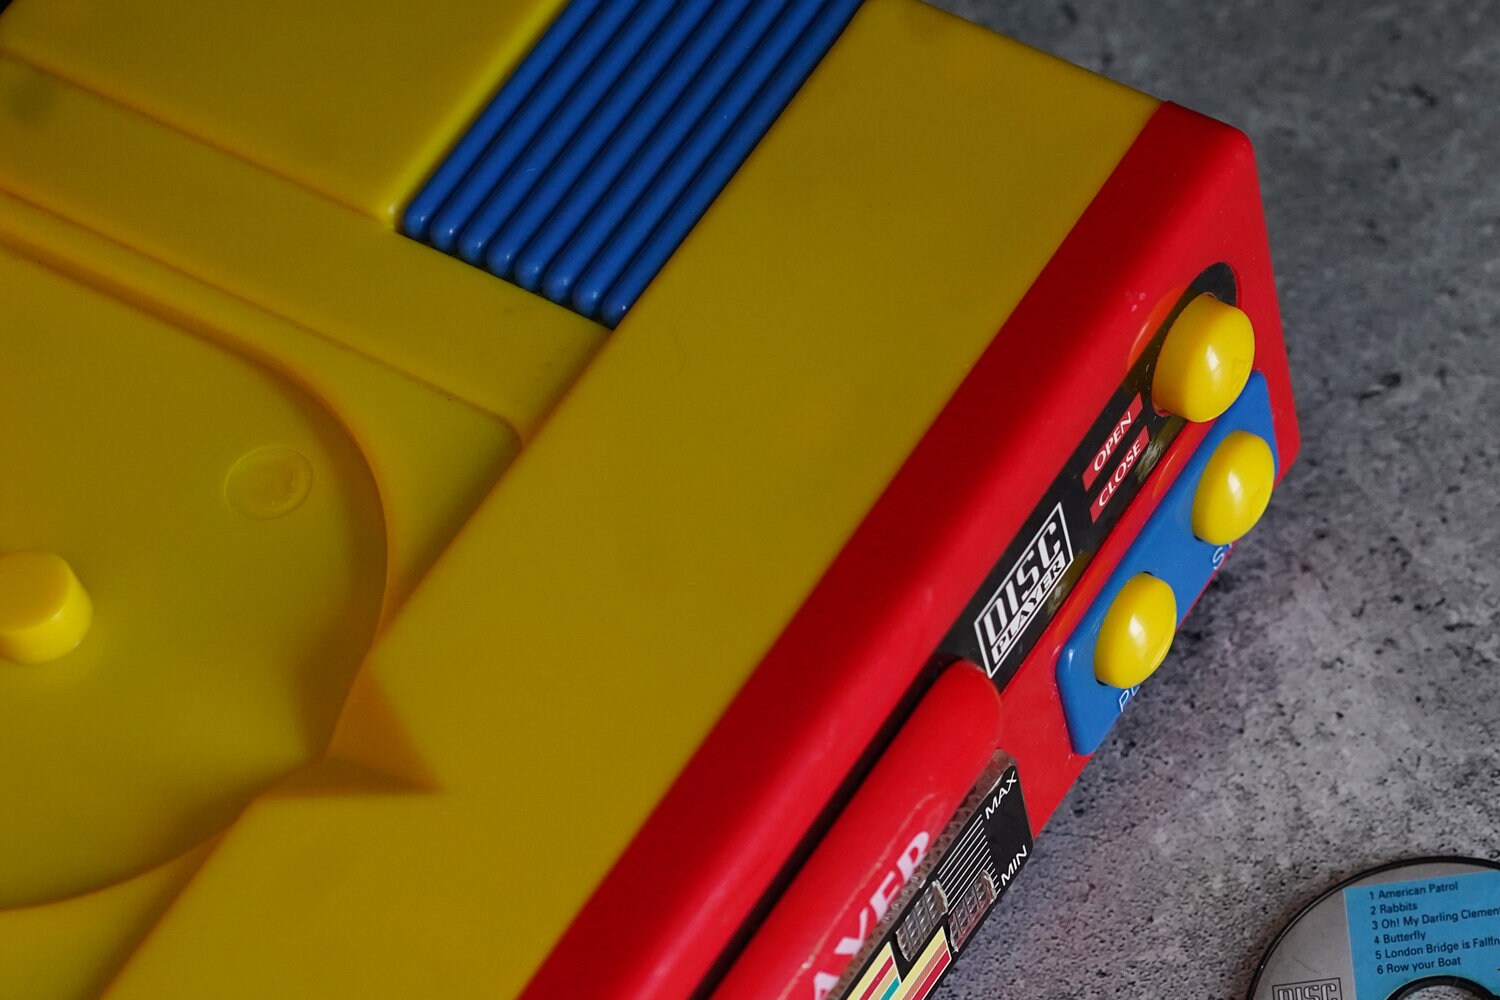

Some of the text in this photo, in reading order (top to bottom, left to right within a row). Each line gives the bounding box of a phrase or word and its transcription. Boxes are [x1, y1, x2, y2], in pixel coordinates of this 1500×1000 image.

[1093, 411, 1132, 472] OPEN
[1098, 439, 1141, 507] CLOSE
[983, 521, 1061, 647] DISC
[993, 553, 1065, 660] PLAYER
[985, 770, 1017, 820] MAX
[1001, 844, 1027, 886] MIN
[1370, 902, 1418, 916] 2 Rabbits
[1373, 930, 1427, 945] 4 Butterfly
[1376, 956, 1461, 975] 6 Row your Boat
